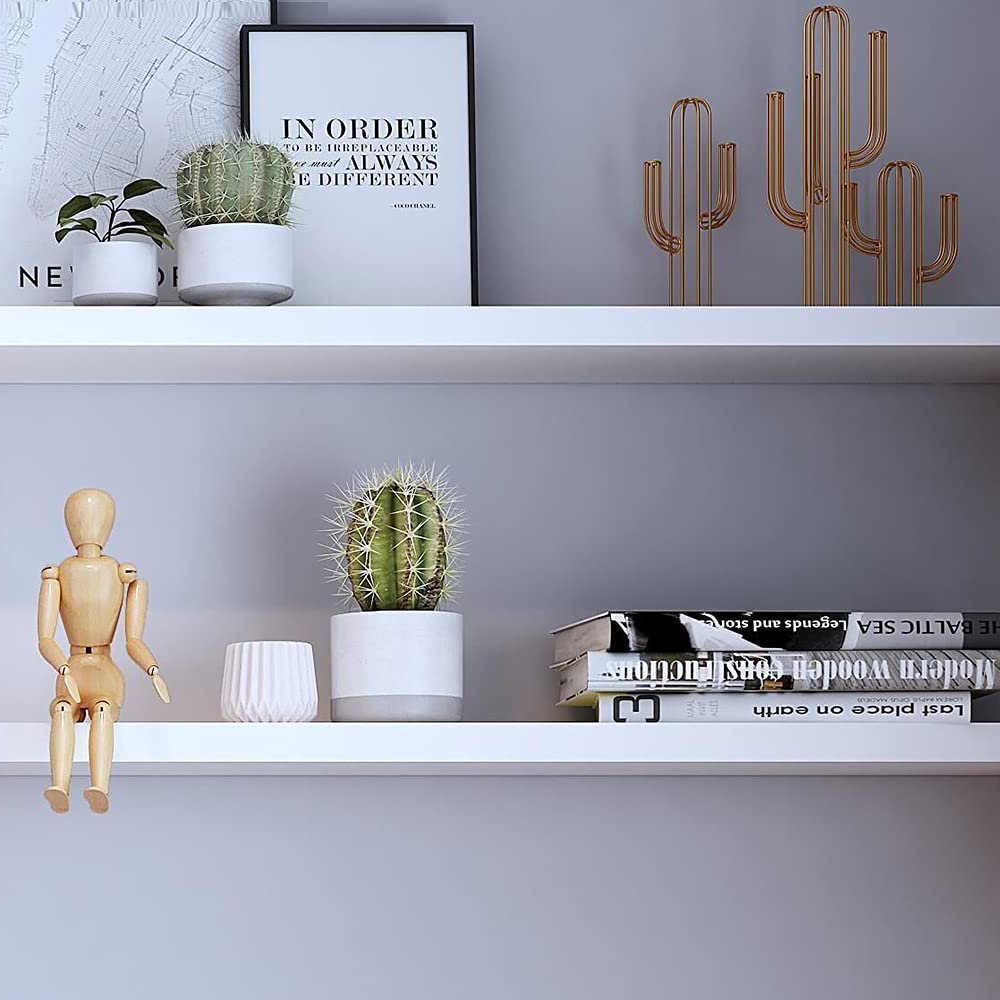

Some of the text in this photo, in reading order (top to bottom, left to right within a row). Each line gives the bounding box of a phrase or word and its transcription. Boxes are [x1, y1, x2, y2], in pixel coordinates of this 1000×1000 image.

[281, 118, 439, 139] IN ORDER
[283, 143, 439, 152] TO BE IRREPLACEABLE
[308, 157, 341, 168] must
[345, 154, 438, 171] ALWAYS
[318, 172, 439, 186] DIFFERENT
[19, 265, 73, 288] NE
[753, 618, 781, 632] and
[785, 616, 848, 632] Legends
[856, 620, 896, 634] SEA
[901, 620, 973, 634] BALTIC
[792, 659, 890, 690] wooden
[900, 659, 997, 690] Modern
[753, 702, 964, 718] Last place on earth
